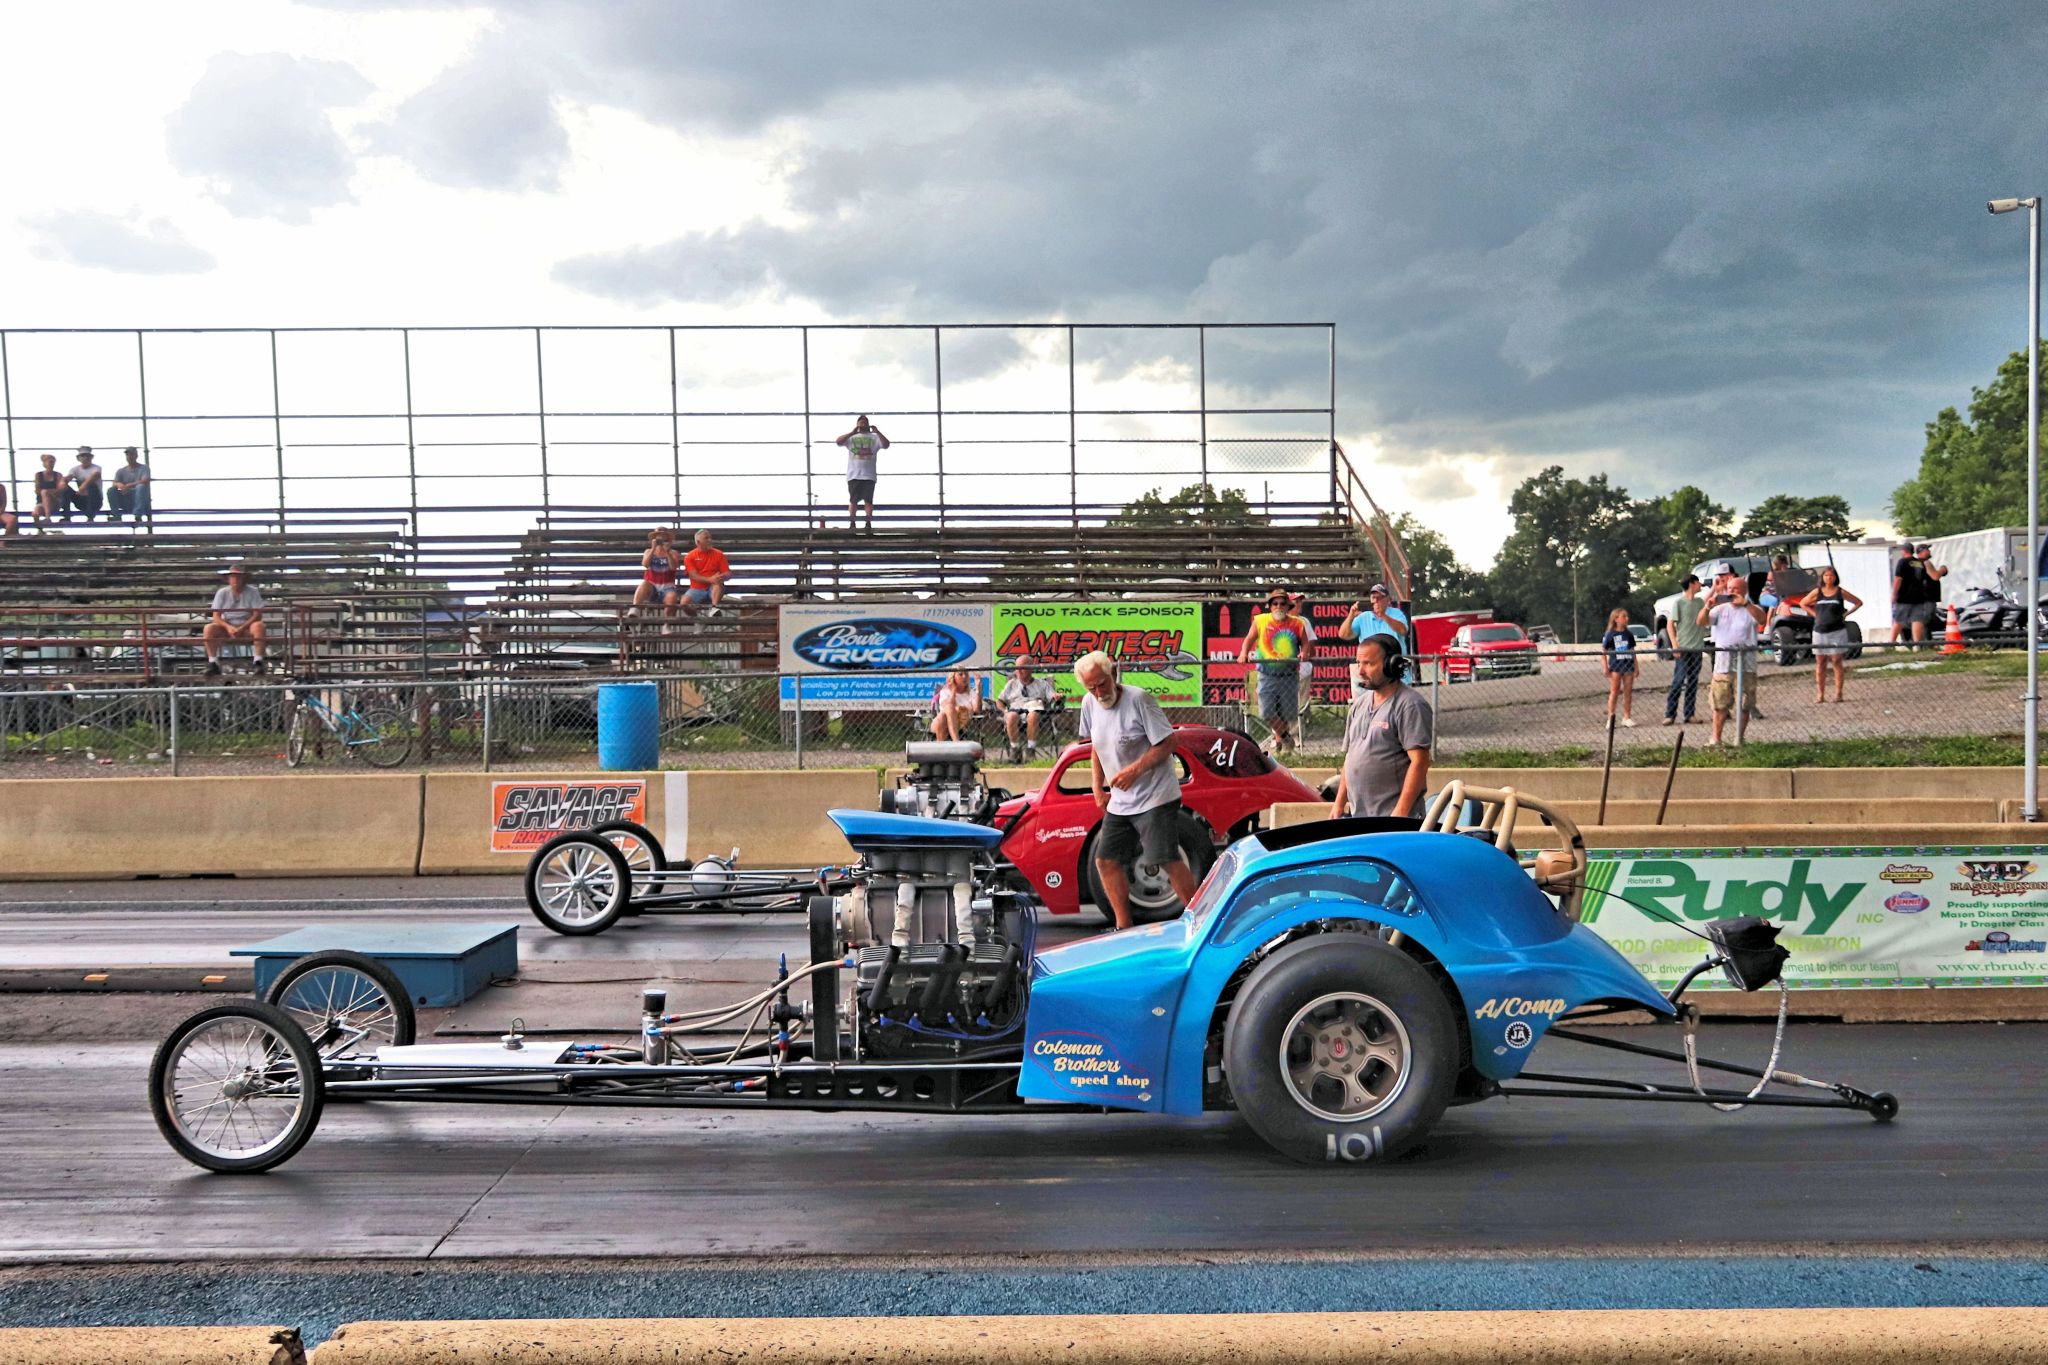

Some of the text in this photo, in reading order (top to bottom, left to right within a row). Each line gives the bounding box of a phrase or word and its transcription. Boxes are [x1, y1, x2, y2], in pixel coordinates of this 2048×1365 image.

[1000, 607, 1195, 617] PROUD TRACK SPONSOR
[1312, 604, 1349, 618] GUNS
[817, 624, 888, 649] Bowie
[810, 647, 943, 664] TRUCKING
[496, 786, 642, 832] SAVAGE
[1627, 877, 1654, 885] Richard
[1621, 859, 1867, 935] Rudy
[1947, 900, 1989, 909] Proudly
[1857, 912, 1885, 924] INC
[1941, 910, 1975, 919] Mason
[1978, 910, 2009, 918] Dixon
[1960, 919, 2045, 928] Jr Dragster Class
[1650, 938, 1708, 953] GRADE
[1816, 962, 1827, 972] to
[1829, 960, 1847, 974] join
[1850, 962, 1867, 972] our
[1474, 996, 1567, 1021] A/Comp
[1033, 1039, 1104, 1056] Coleman
[1053, 1056, 1121, 1073] Brothers
[1070, 1074, 1150, 1089] speed shop
